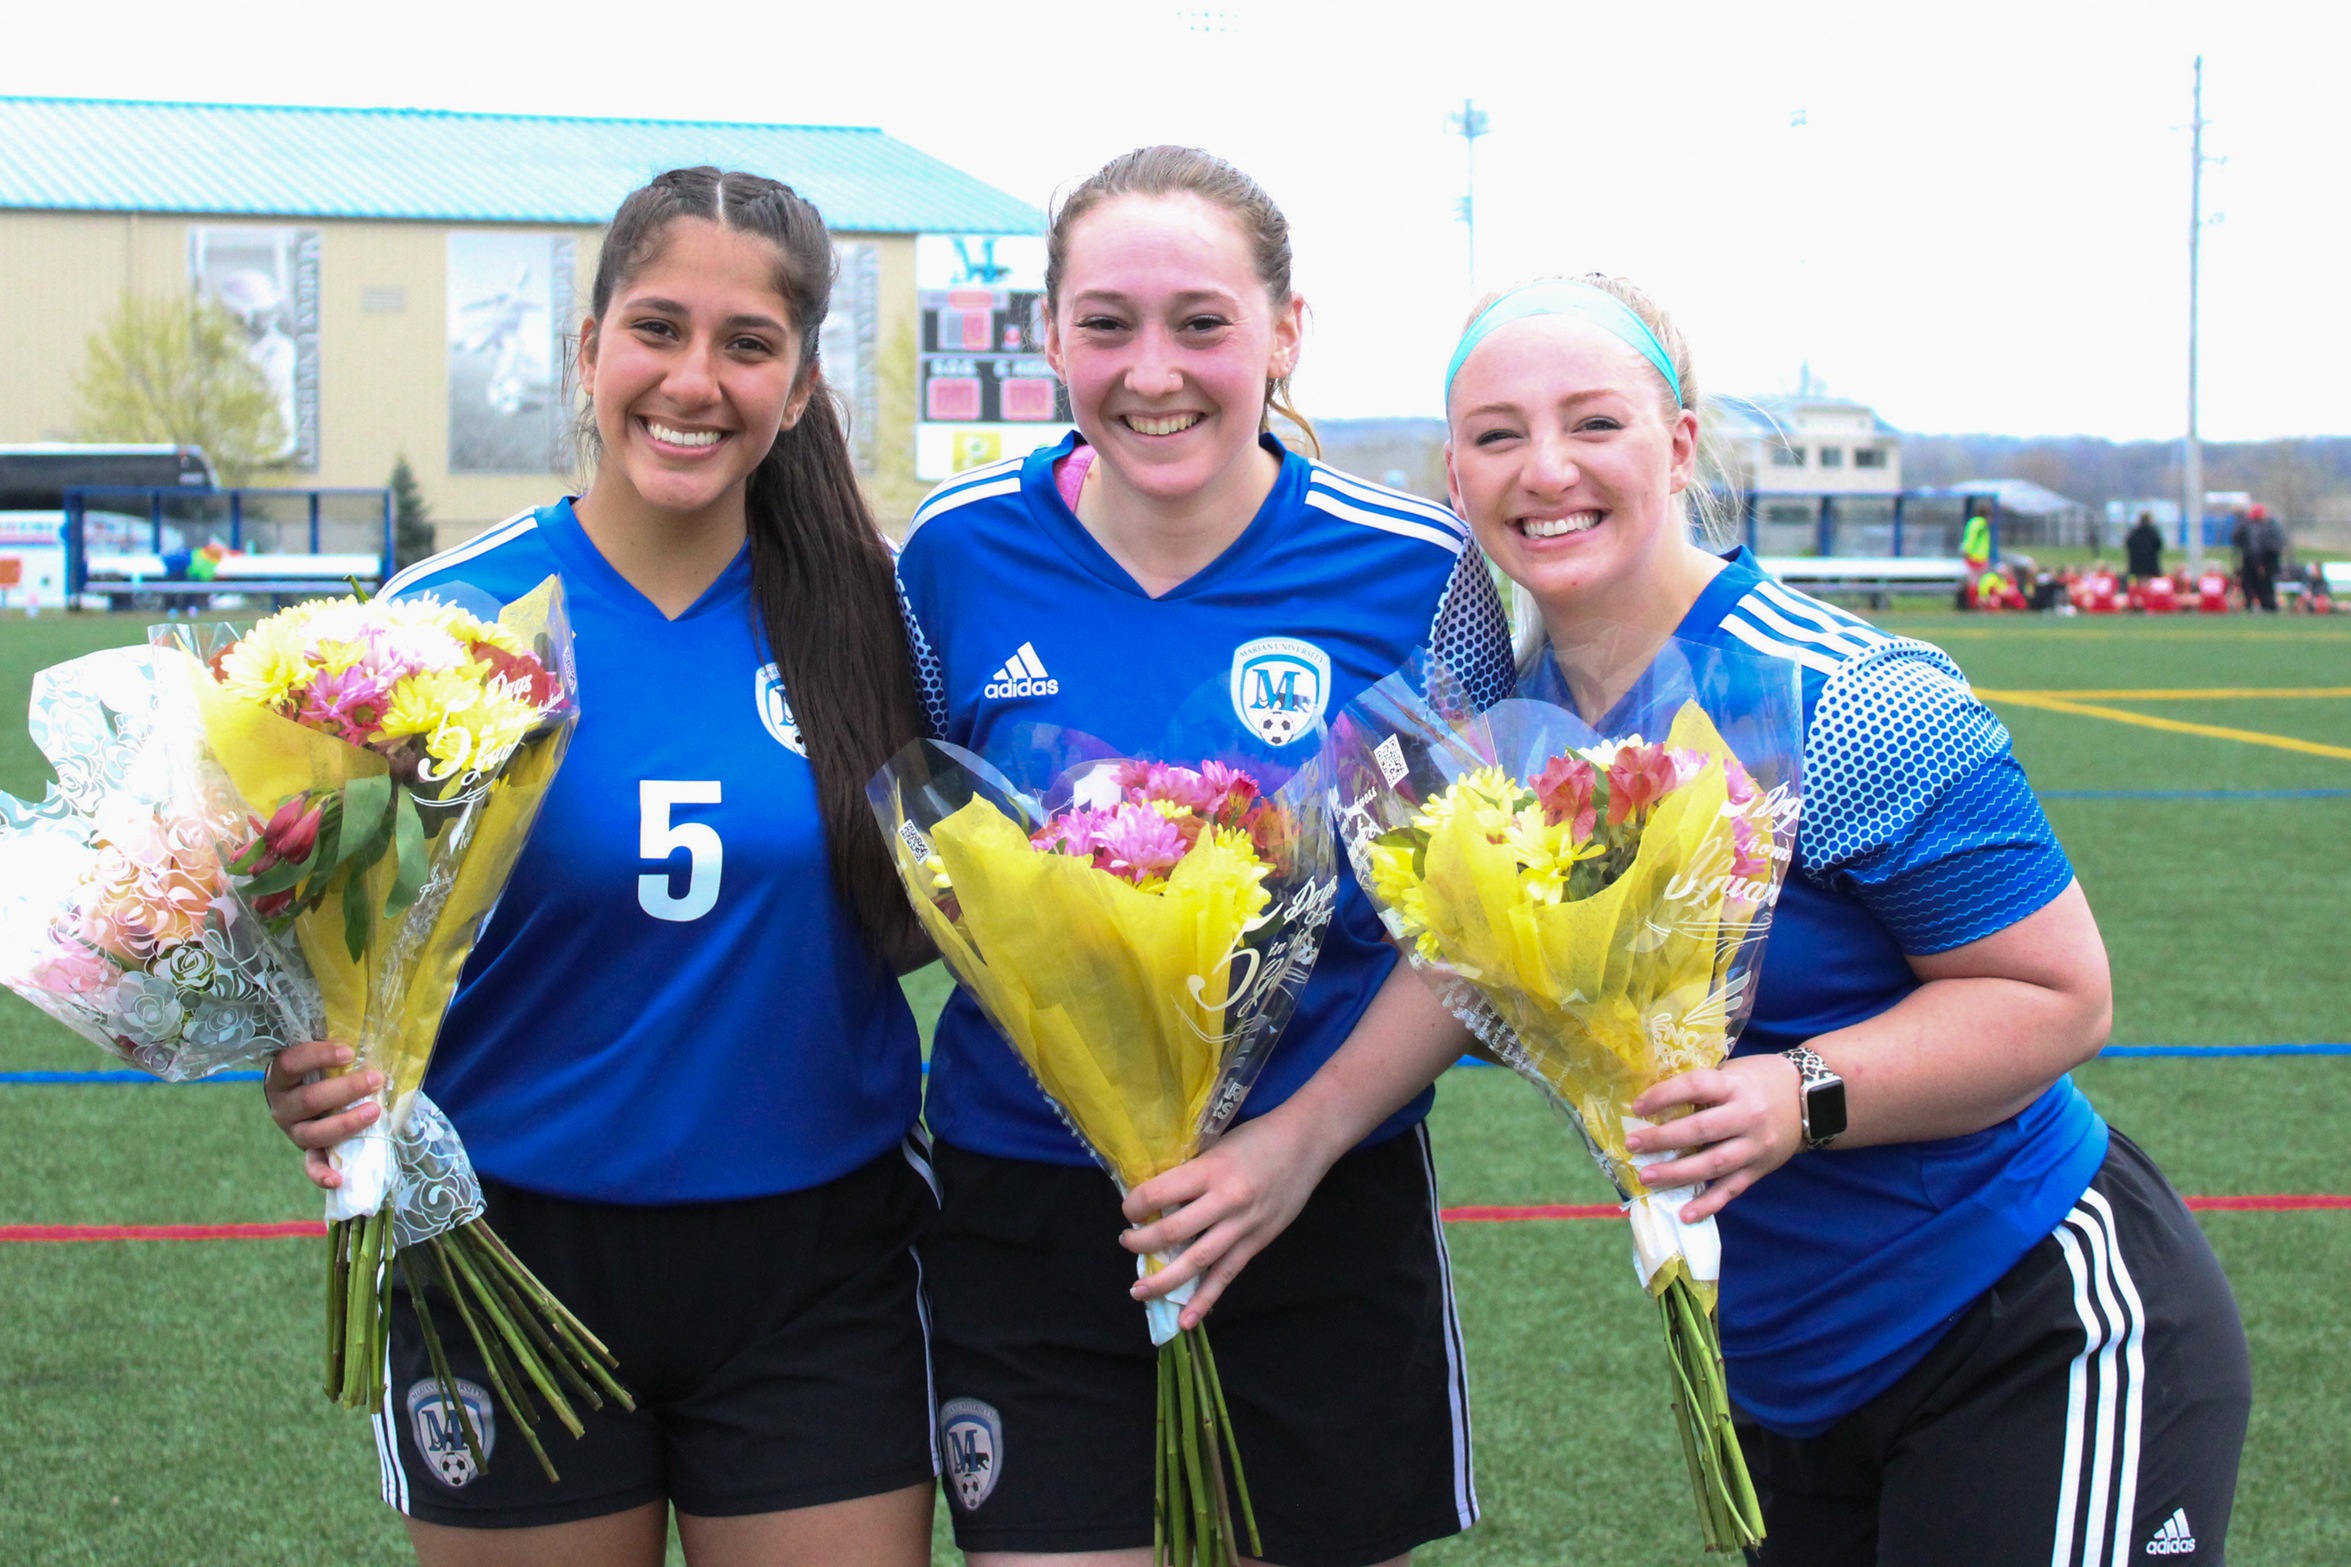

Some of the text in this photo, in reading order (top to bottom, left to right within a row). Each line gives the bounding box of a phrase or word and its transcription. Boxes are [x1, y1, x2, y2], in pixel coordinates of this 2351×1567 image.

[1239, 643, 1325, 664] MARIAN UNIVERSITY
[984, 677, 1059, 699] adidas
[637, 779, 723, 922] 5
[948, 1429, 981, 1474] M
[2145, 1537, 2196, 1555] adidas
